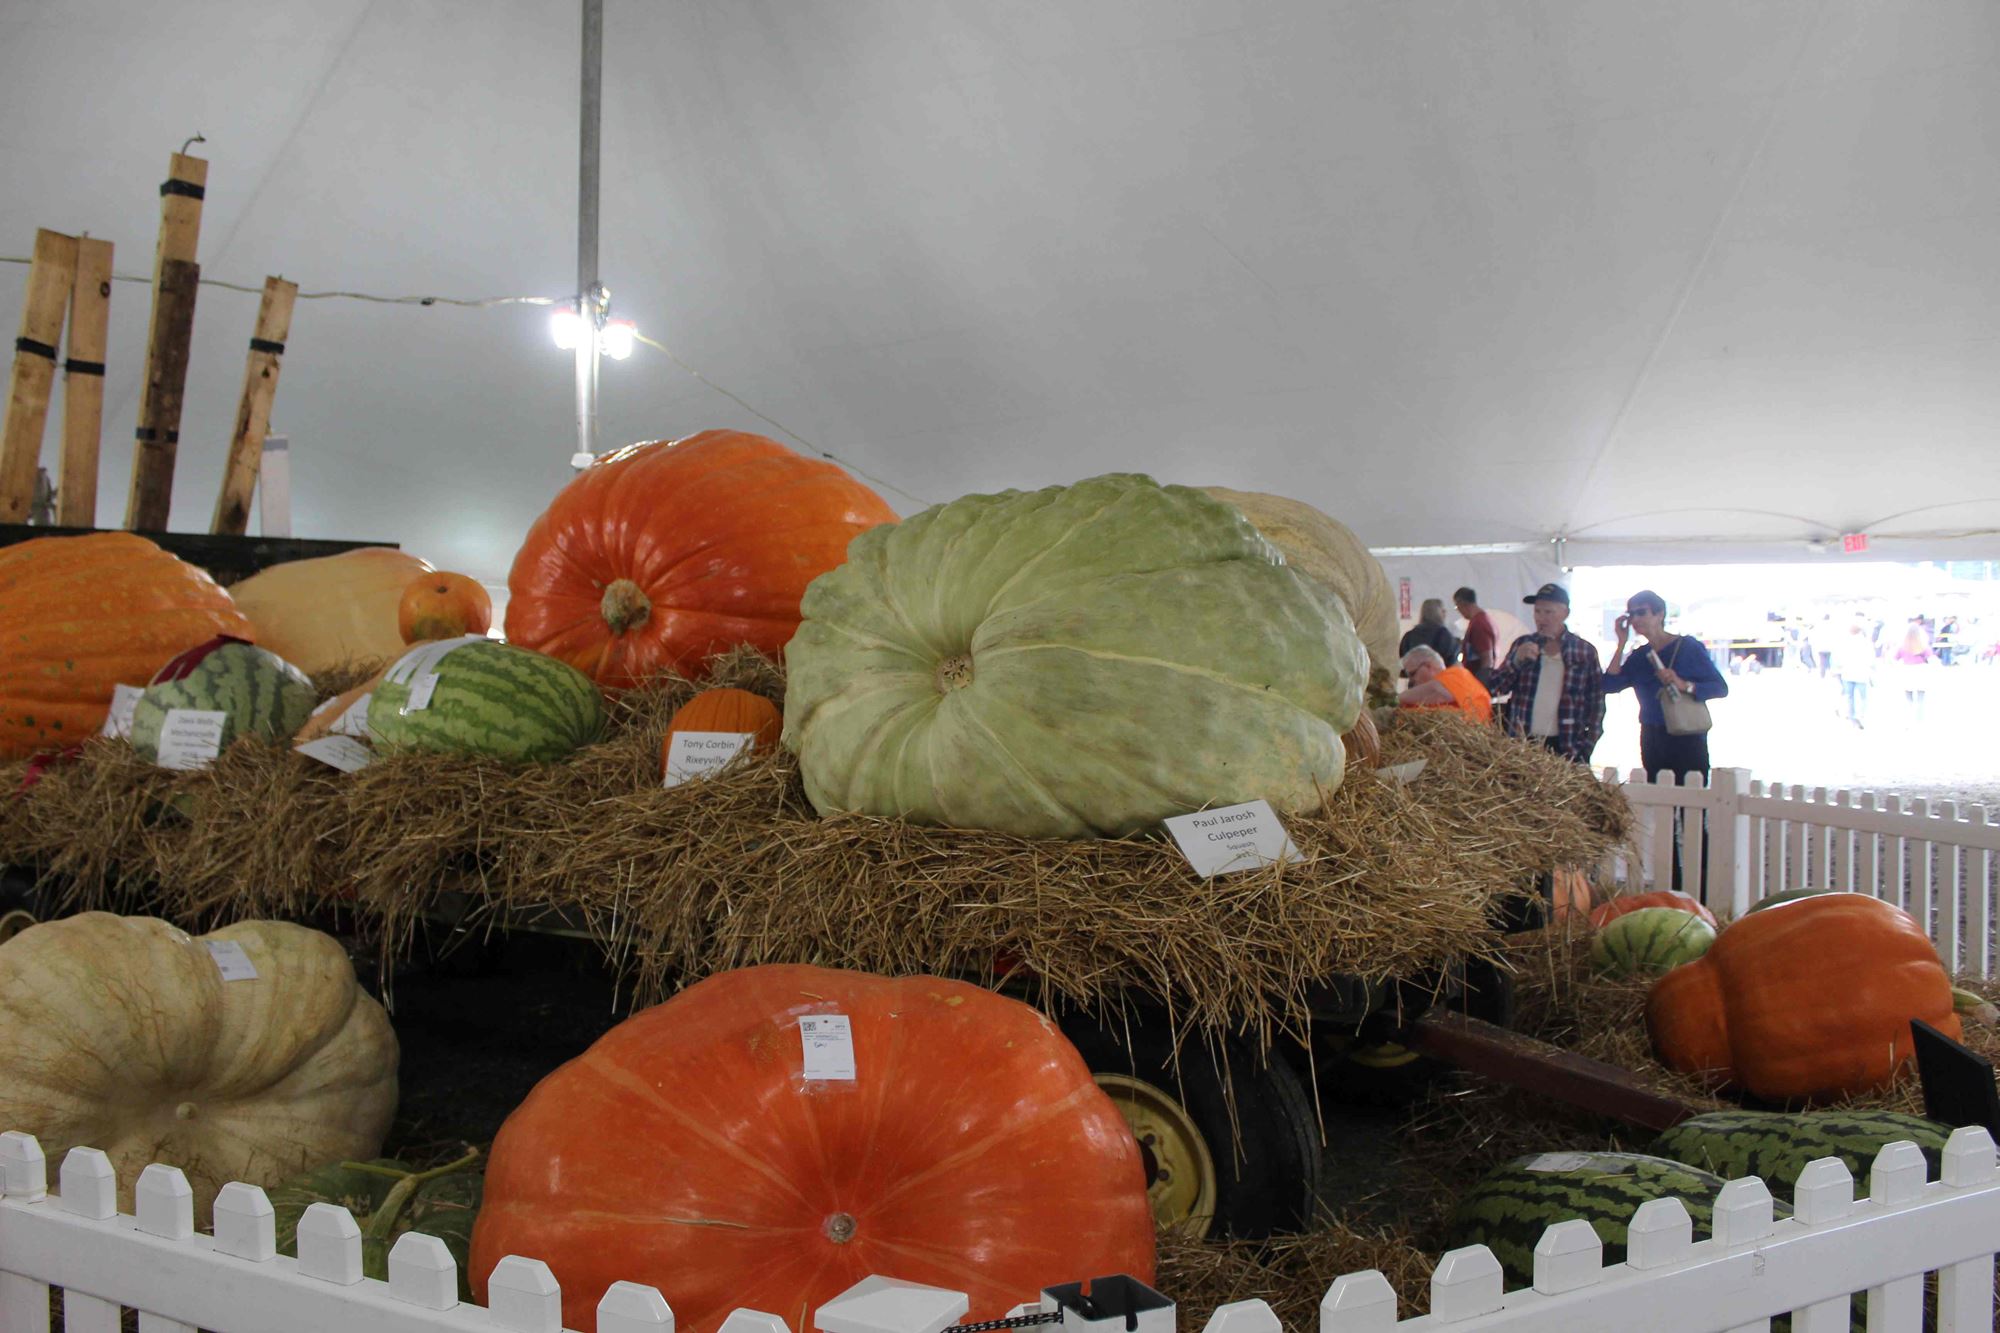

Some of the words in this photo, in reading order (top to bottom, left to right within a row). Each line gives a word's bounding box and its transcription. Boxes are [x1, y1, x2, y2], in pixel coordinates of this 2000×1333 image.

[1843, 534, 1868, 552] EXIT
[683, 739, 704, 750] Tony
[705, 740, 735, 749] Corbin
[685, 755, 726, 765] Rixeyville
[1192, 816, 1218, 828] Paul
[1220, 810, 1256, 825] Jarosh
[1207, 826, 1259, 842] Culpeper
